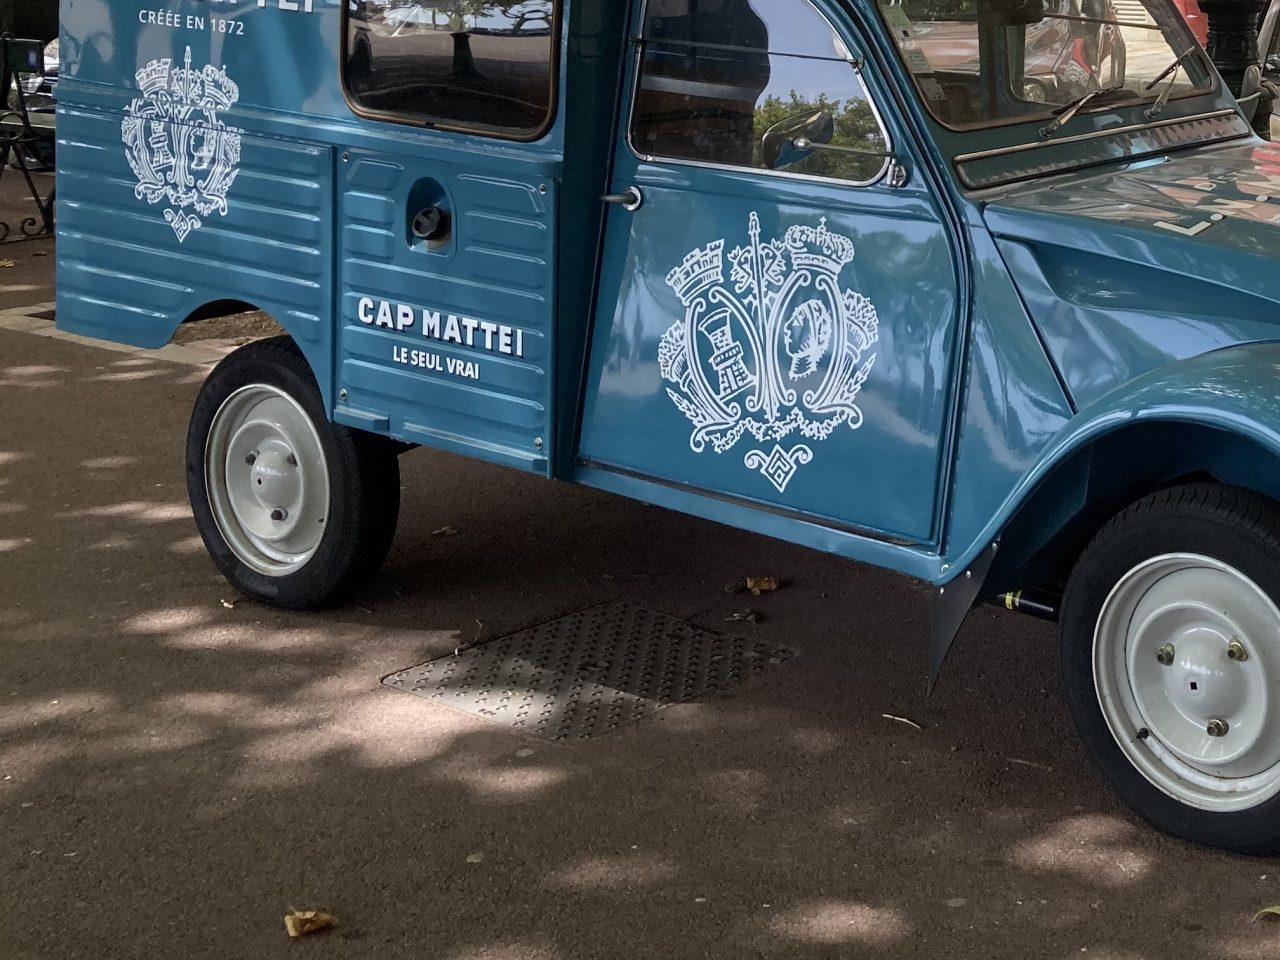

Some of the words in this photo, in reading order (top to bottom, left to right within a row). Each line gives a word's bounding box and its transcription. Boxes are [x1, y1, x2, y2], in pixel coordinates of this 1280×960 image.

[138, 8, 181, 27] CRÉÉE
[186, 15, 204, 31] EN
[210, 18, 245, 36] 1872
[358, 297, 415, 331] CAP
[422, 309, 524, 357] MATTEI
[392, 345, 408, 364] LE
[410, 349, 444, 372] SEUL
[446, 357, 479, 380] VRAI
